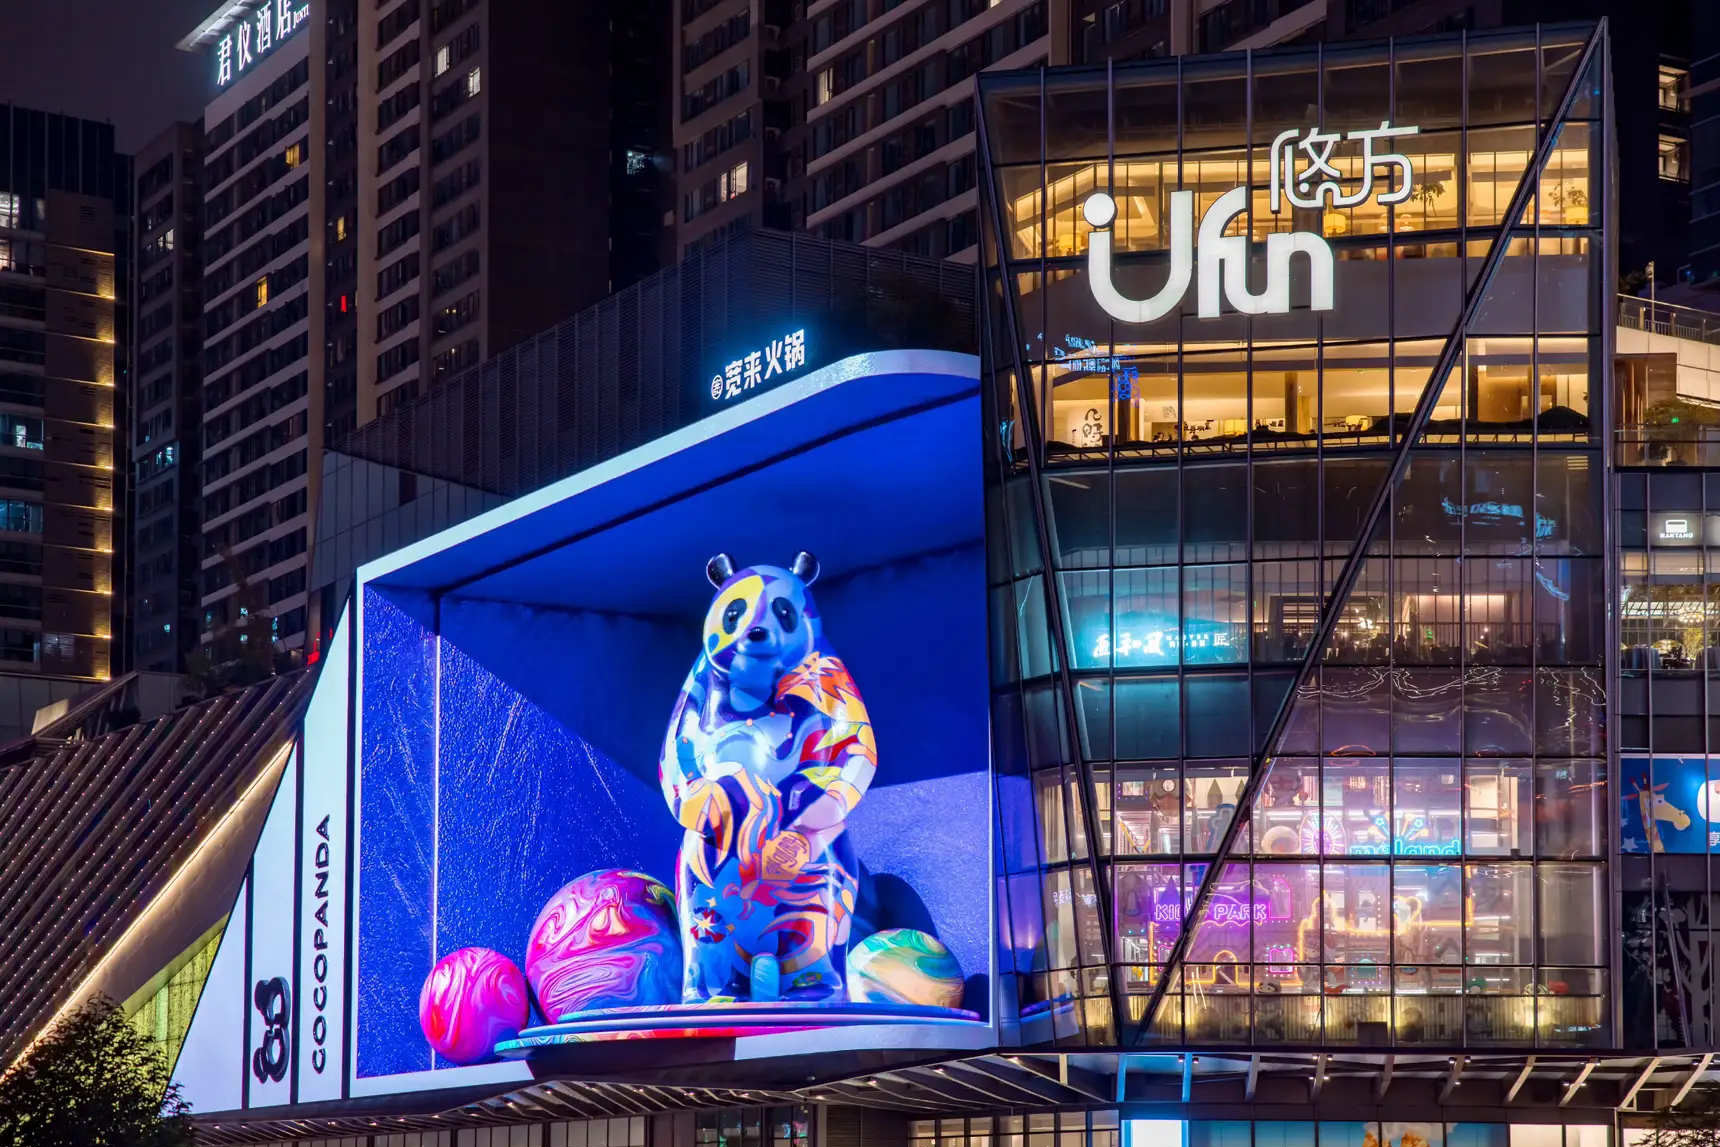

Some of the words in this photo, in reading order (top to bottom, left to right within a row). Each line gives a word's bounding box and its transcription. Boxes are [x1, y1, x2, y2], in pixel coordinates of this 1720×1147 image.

[1271, 121, 1419, 214] 悠方
[725, 329, 805, 399] 宽来火锅
[312, 814, 330, 1074] COCOPANDA
[1214, 904, 1268, 920] PARK
